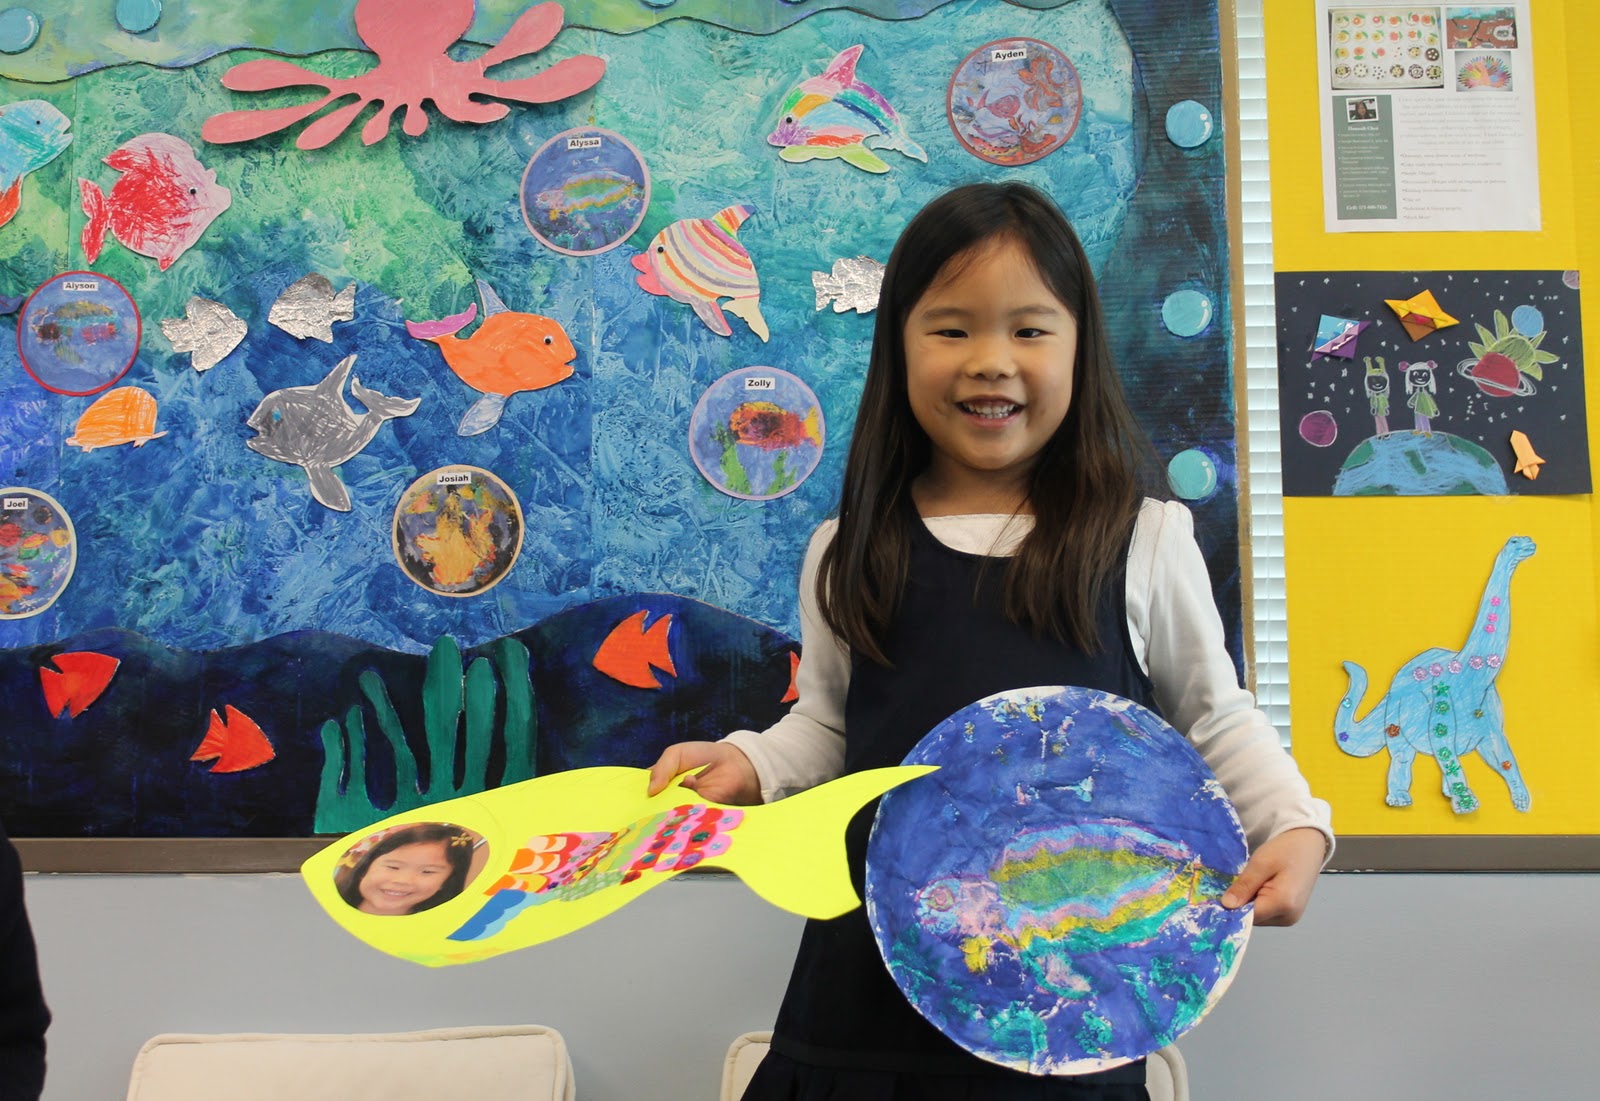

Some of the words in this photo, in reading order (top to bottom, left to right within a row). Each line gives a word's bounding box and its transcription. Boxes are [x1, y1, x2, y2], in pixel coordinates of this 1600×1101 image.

[995, 50, 1024, 60] Ayden
[570, 138, 599, 148] Alyssa
[65, 282, 95, 290] Alyson
[748, 379, 771, 388] Zolly
[439, 474, 469, 483] Josiah
[7, 500, 26, 508] Joel
